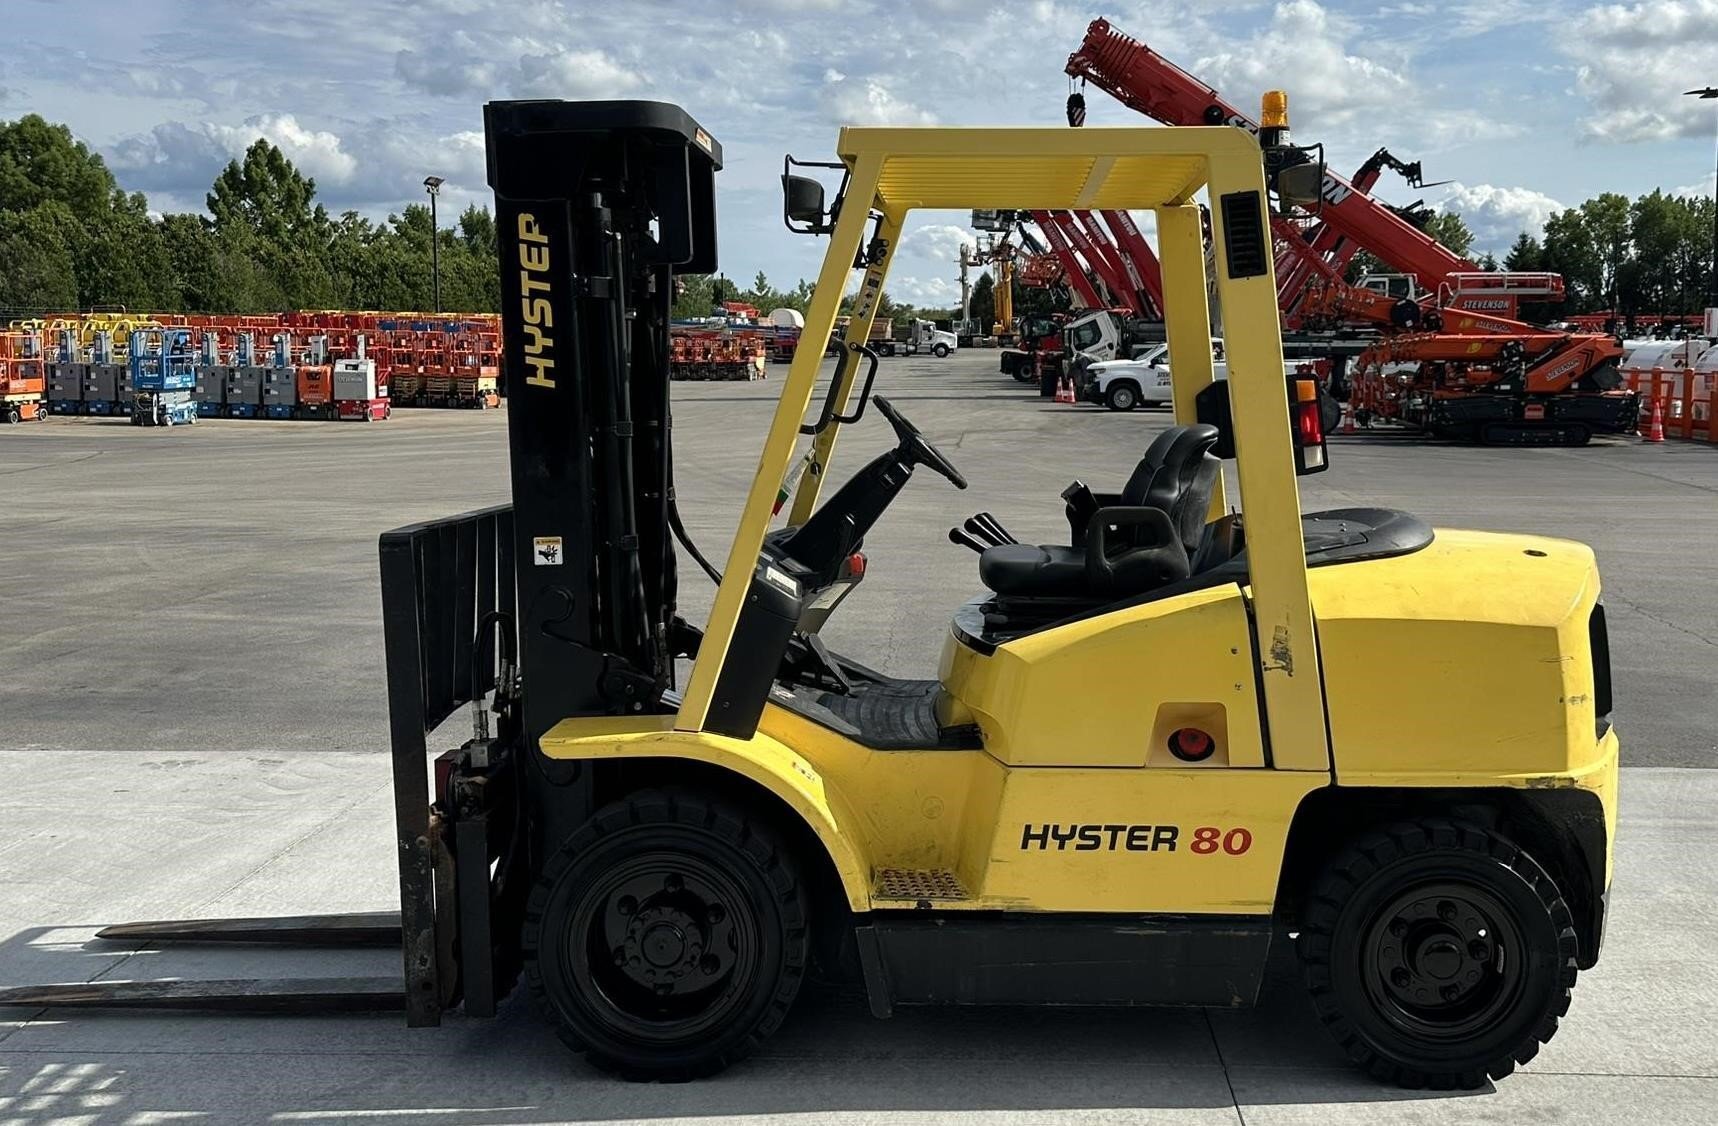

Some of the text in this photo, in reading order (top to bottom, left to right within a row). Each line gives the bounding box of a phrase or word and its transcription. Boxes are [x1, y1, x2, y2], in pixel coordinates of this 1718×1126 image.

[518, 212, 556, 388] HYSTER
[1462, 299, 1510, 310] STEVENSON
[1020, 824, 1252, 856] HYSTER 80
